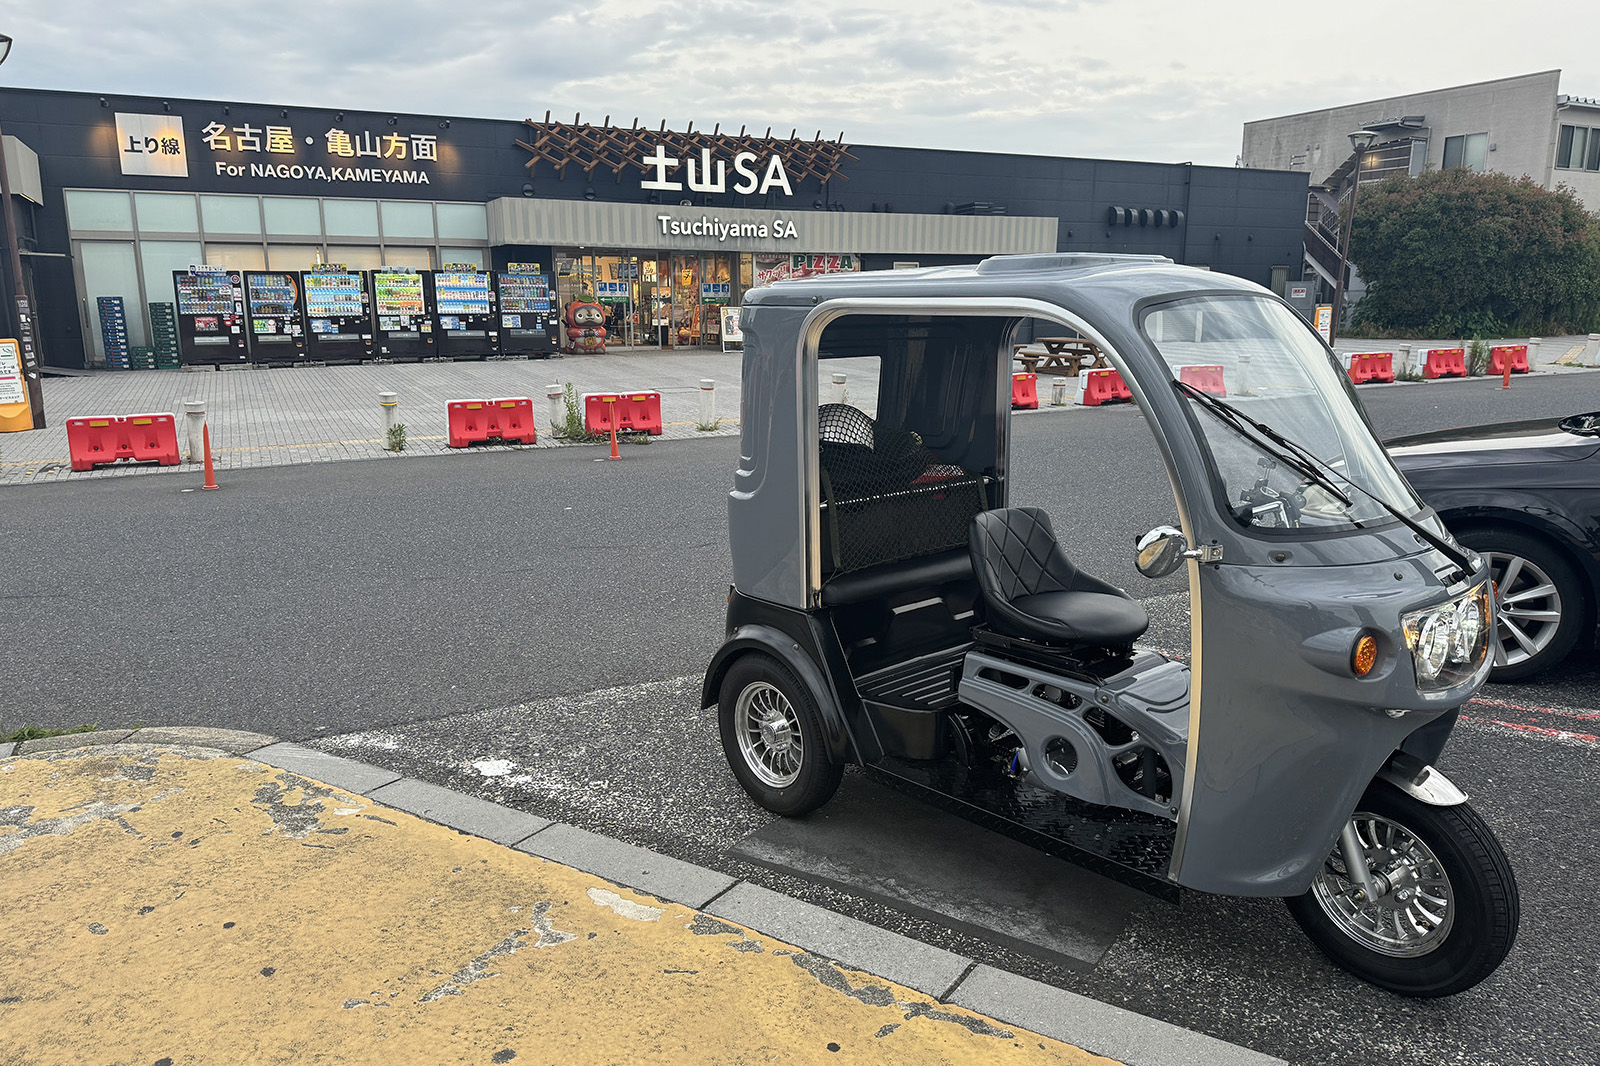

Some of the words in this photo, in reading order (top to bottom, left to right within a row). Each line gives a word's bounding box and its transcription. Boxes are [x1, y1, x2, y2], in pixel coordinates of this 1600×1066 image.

[123, 135, 181, 155] 上り線
[201, 120, 437, 161] 名古屋・亀山方面
[216, 161, 245, 177] For
[251, 163, 429, 184] NAGOYA,KAMEYAMA
[641, 145, 793, 196] 土山SA
[657, 215, 768, 241] Tsuchiyama
[773, 219, 798, 238] SA
[793, 254, 853, 269] PIZZA
